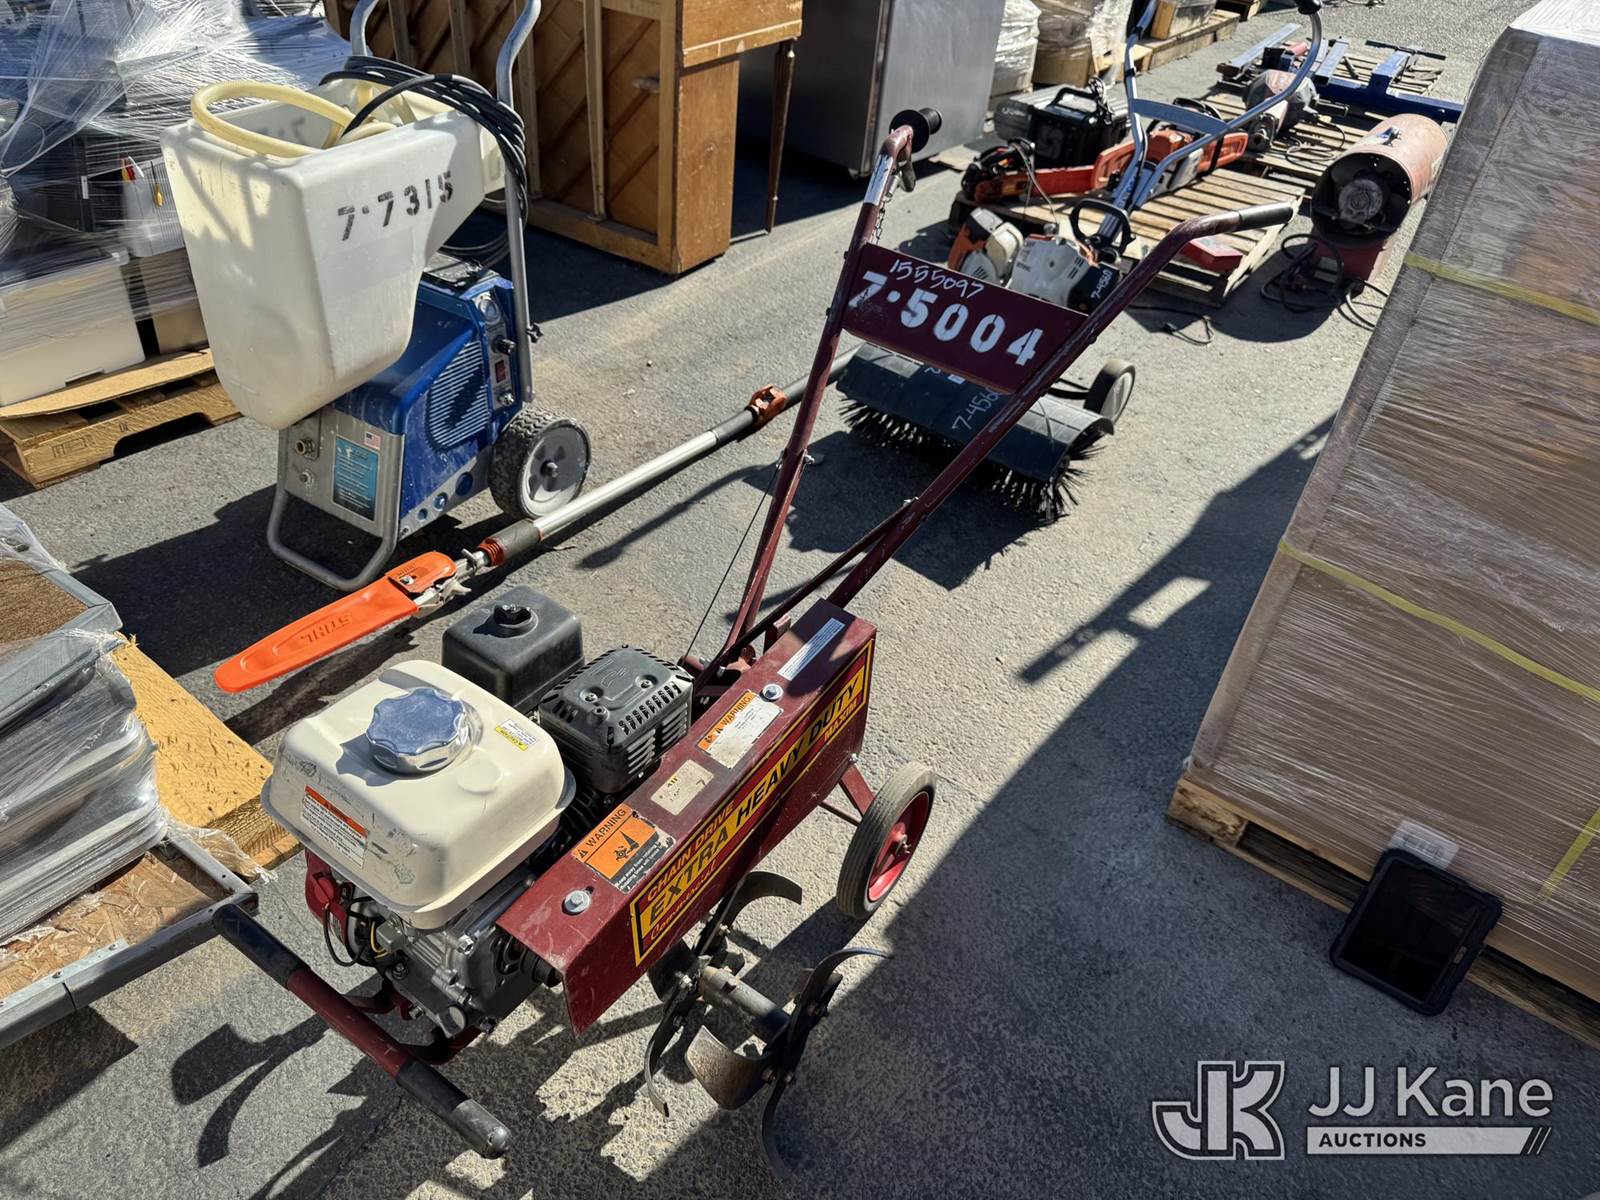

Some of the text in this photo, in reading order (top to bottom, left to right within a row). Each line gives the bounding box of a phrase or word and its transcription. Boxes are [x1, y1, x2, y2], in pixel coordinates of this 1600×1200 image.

[889, 259, 984, 299] 1555097
[823, 698, 858, 742] MAXIM
[650, 826, 729, 926] EXTRA
[736, 738, 804, 828] HEAVY
[808, 677, 860, 747] DUTY
[585, 808, 627, 848] WARNING
[648, 848, 692, 901] CHAIN
[695, 803, 734, 848] DRIVE
